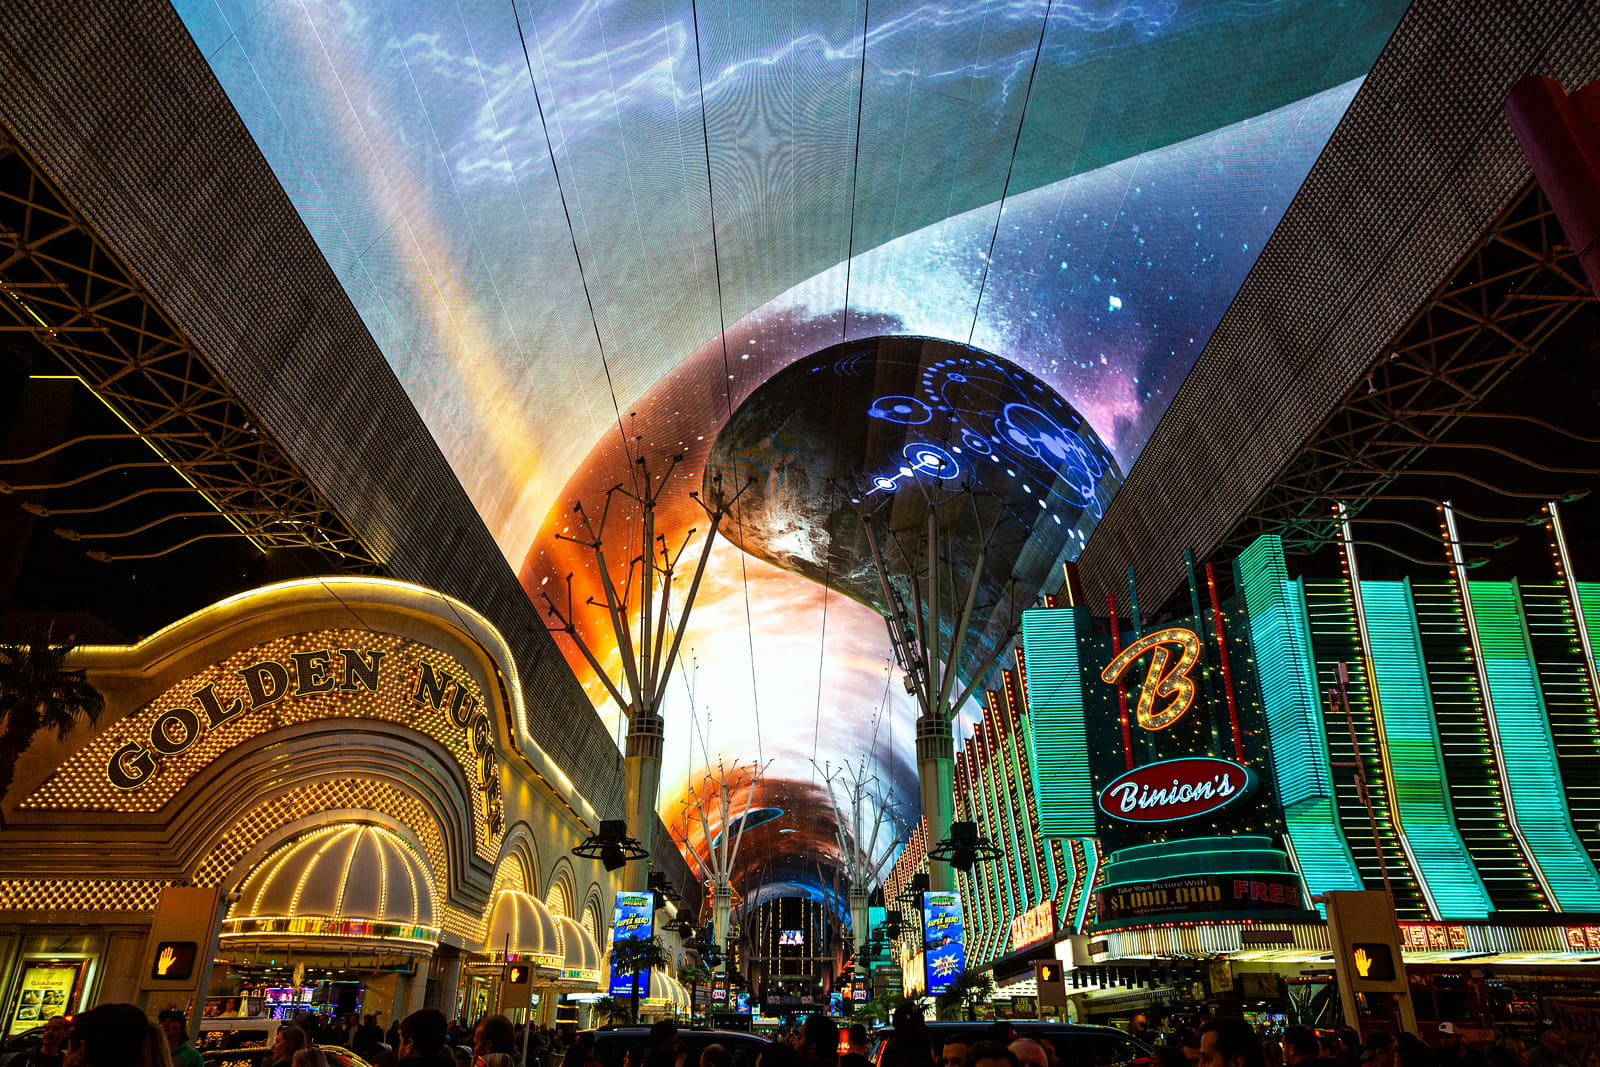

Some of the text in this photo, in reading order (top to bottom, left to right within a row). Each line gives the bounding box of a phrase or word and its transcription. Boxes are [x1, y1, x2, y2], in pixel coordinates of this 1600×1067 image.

[1100, 627, 1200, 731] B
[106, 647, 501, 846] GOLDEN NUGGET
[1110, 772, 1235, 813] Binion's
[1152, 881, 1184, 890] Picture
[1184, 878, 1207, 887] With
[1232, 879, 1298, 906] FREE
[1110, 885, 1222, 911] $1,000,000
[616, 917, 650, 928] SUPER HERO
[927, 917, 960, 928] SUPER HERO
